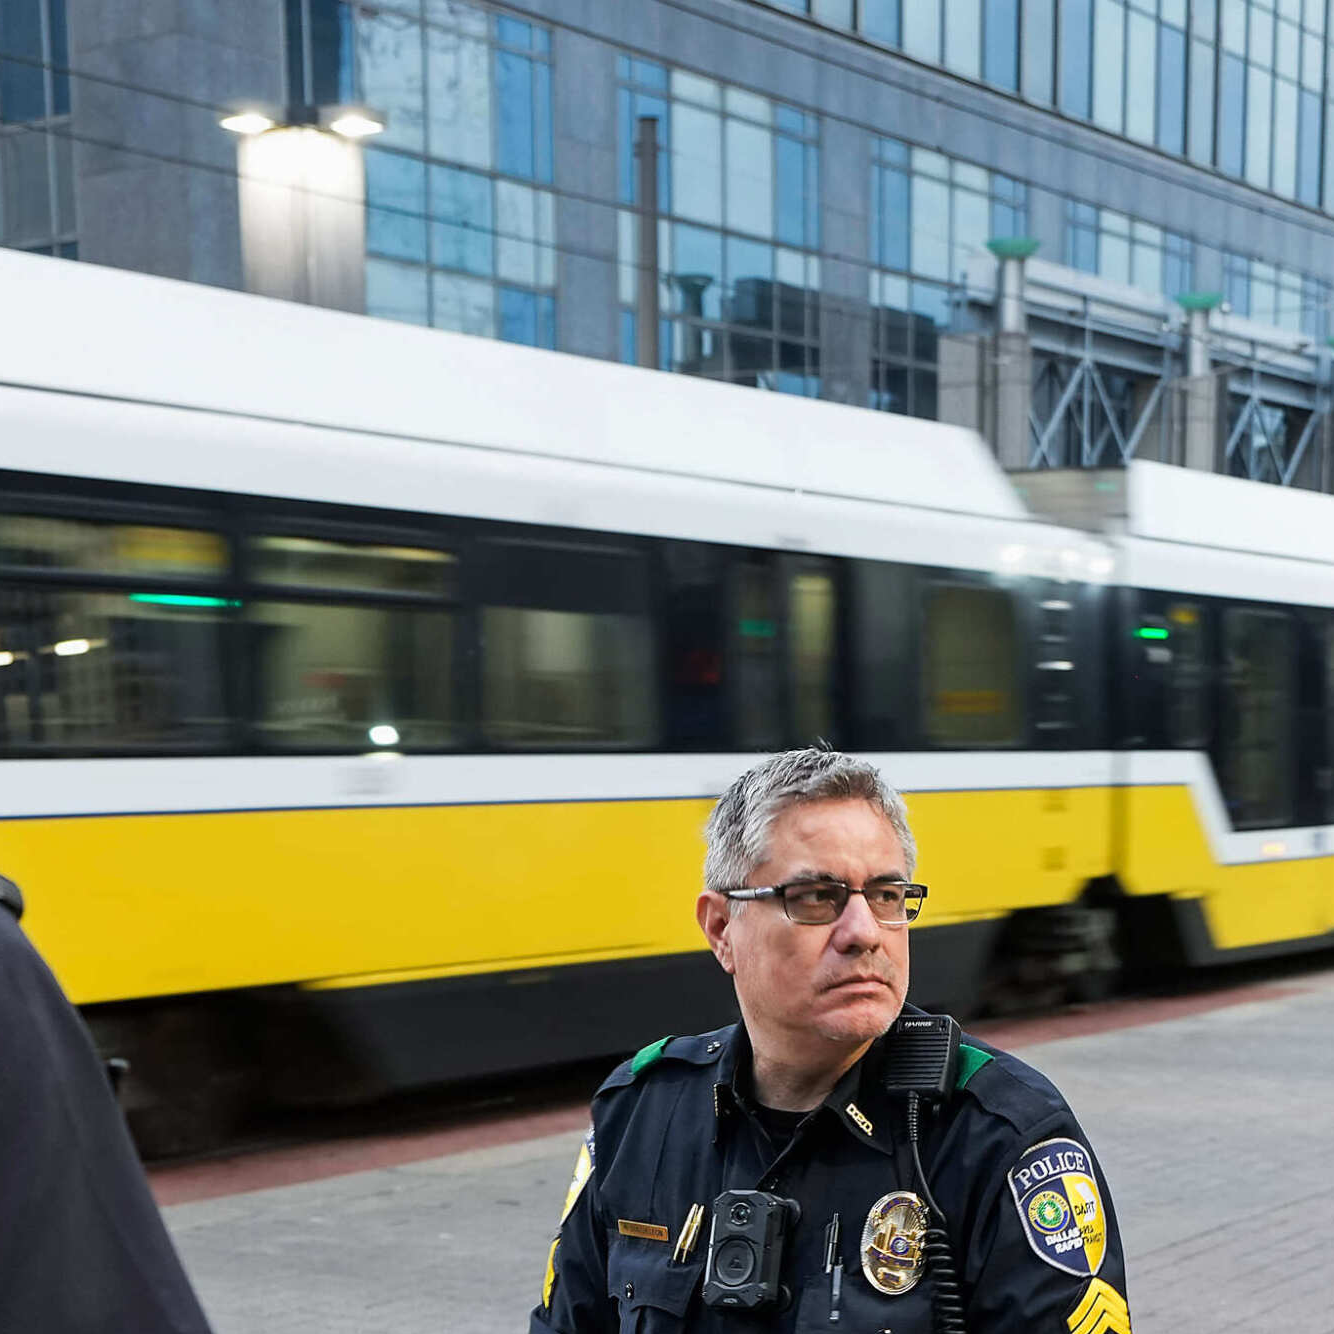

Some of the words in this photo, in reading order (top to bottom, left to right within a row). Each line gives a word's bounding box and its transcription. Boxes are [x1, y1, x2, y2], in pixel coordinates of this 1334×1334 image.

[1014, 1152, 1085, 1190] POLICE
[1074, 1201, 1095, 1217] DART
[1045, 1227, 1080, 1246] DALLAS
[1055, 1238, 1083, 1254] RAPID
